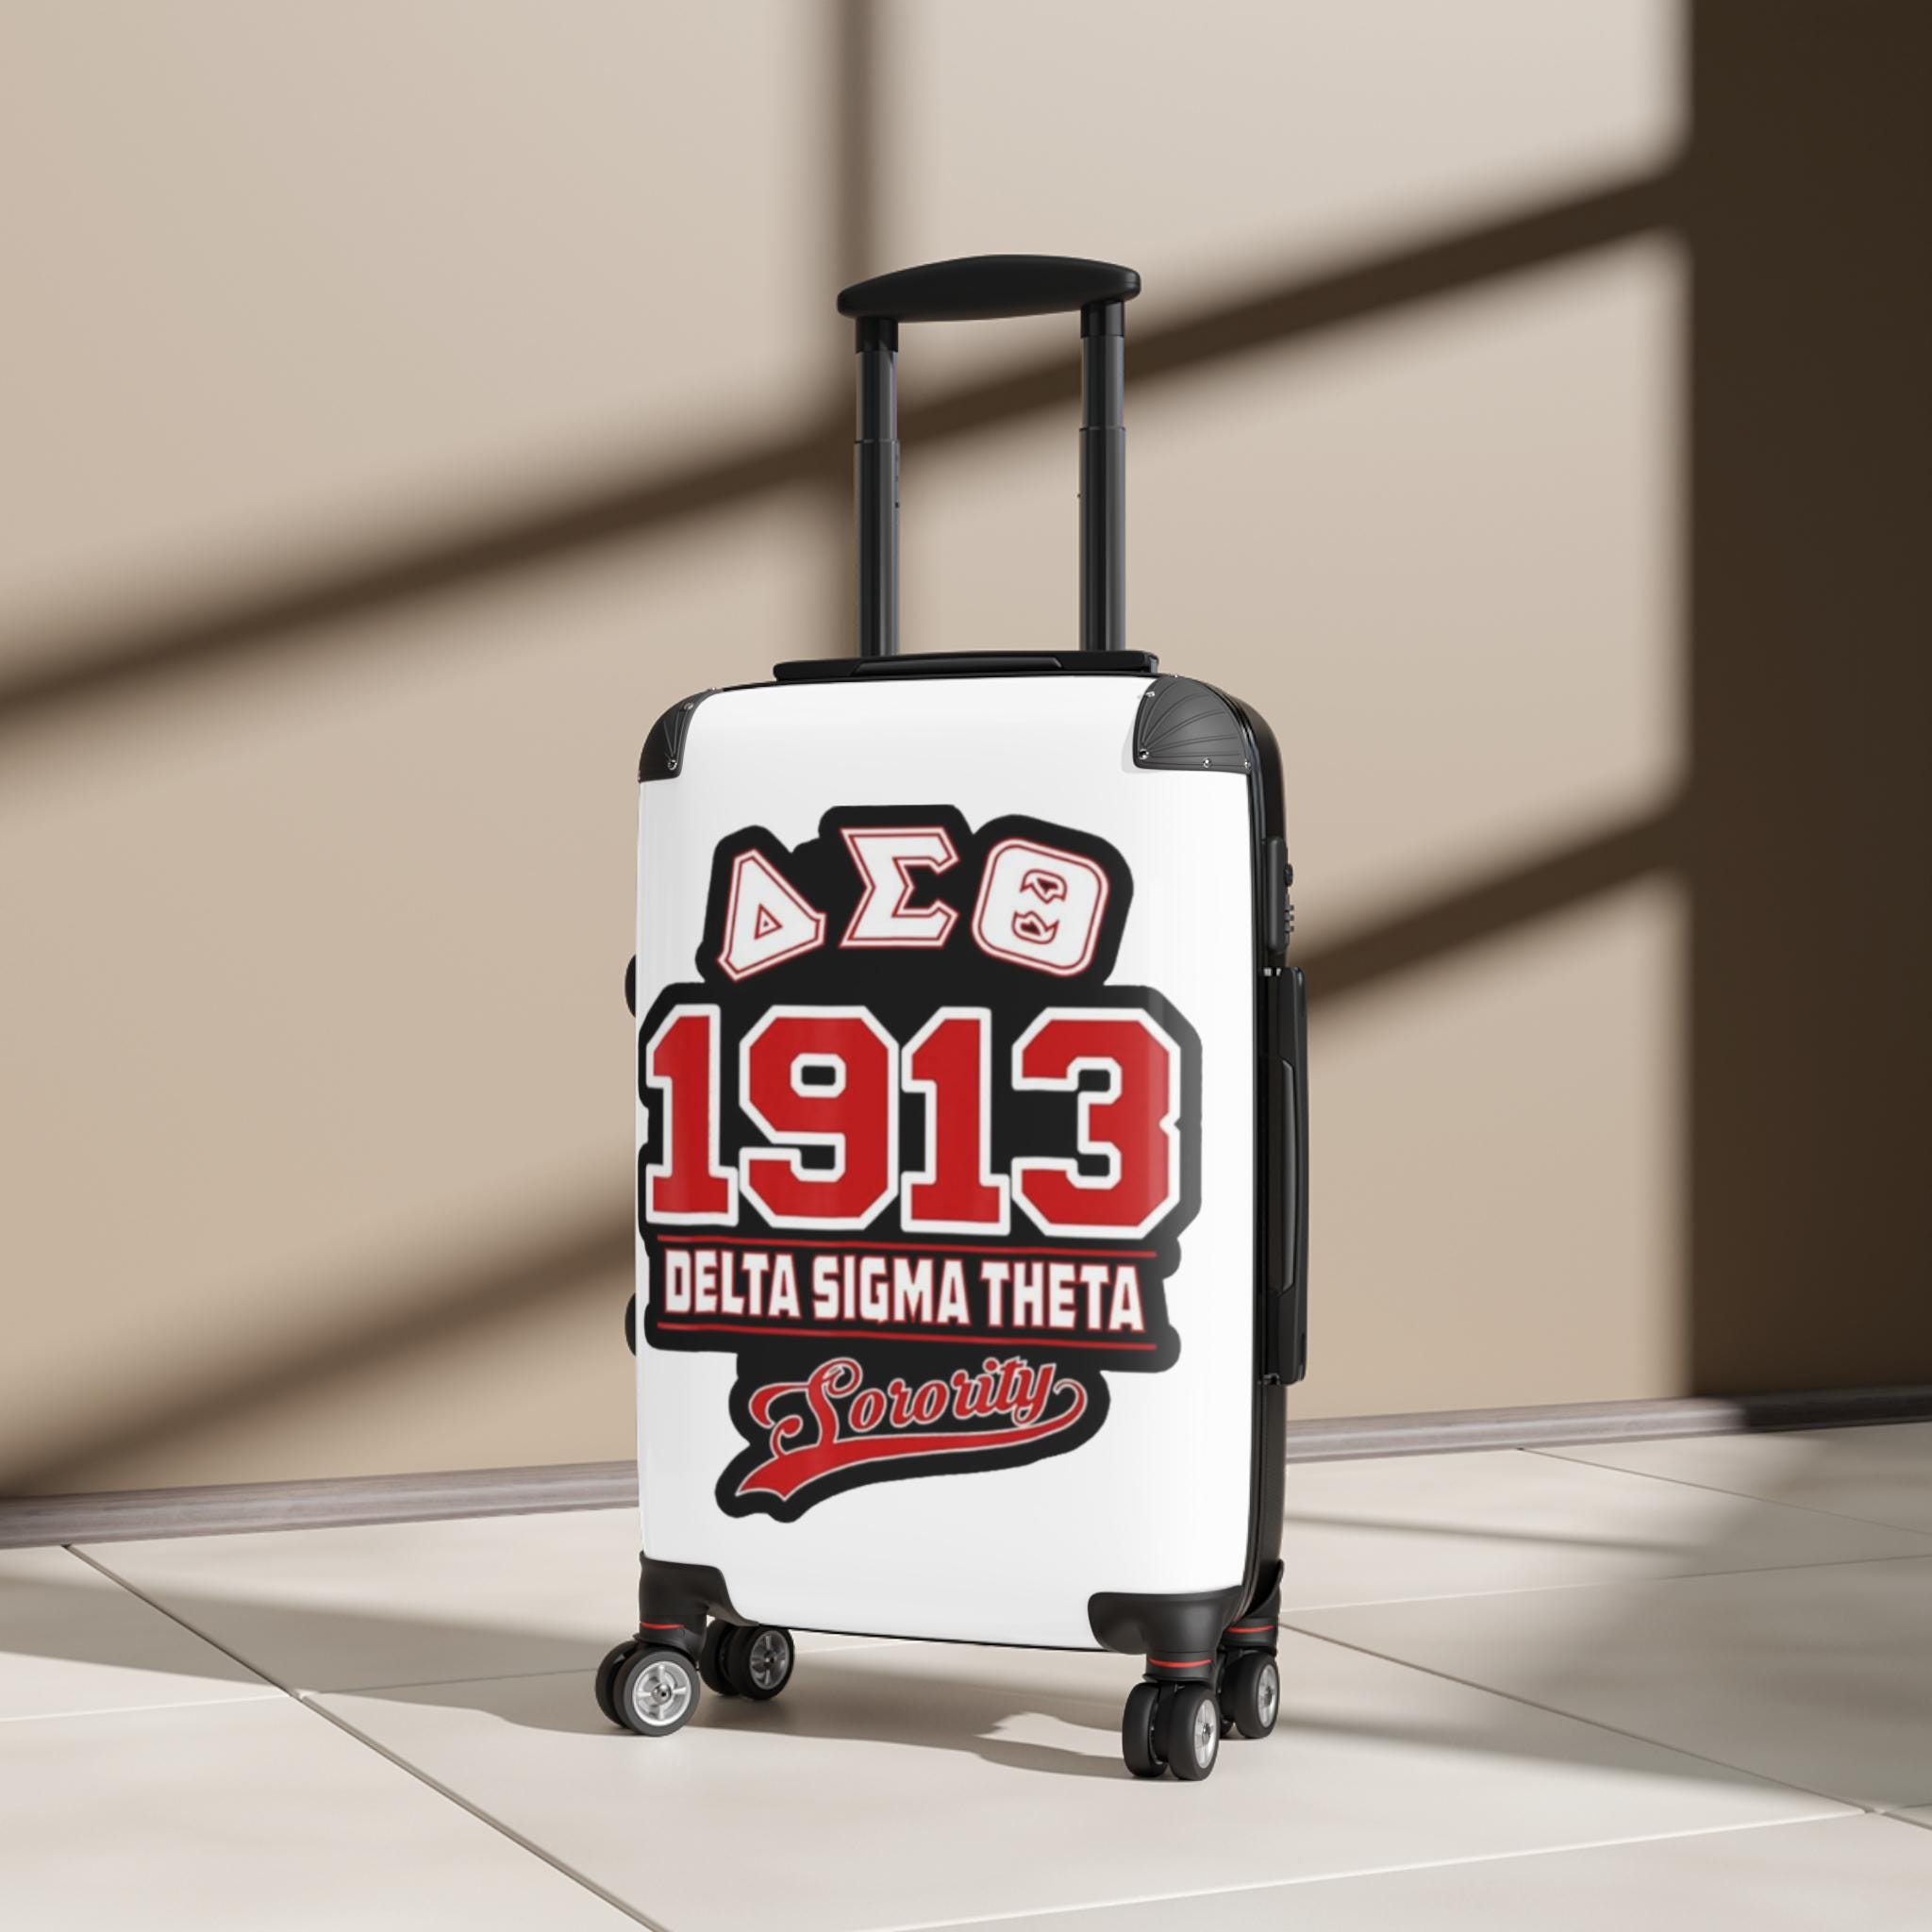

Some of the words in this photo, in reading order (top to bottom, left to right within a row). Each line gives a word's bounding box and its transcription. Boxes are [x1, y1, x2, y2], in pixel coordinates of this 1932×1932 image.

[646, 1004, 1181, 1239] 1913
[664, 1247, 801, 1319] DELTA
[812, 1254, 971, 1325] SIGMA
[979, 1260, 1145, 1333] THETA
[748, 1357, 1087, 1462] Sorority
